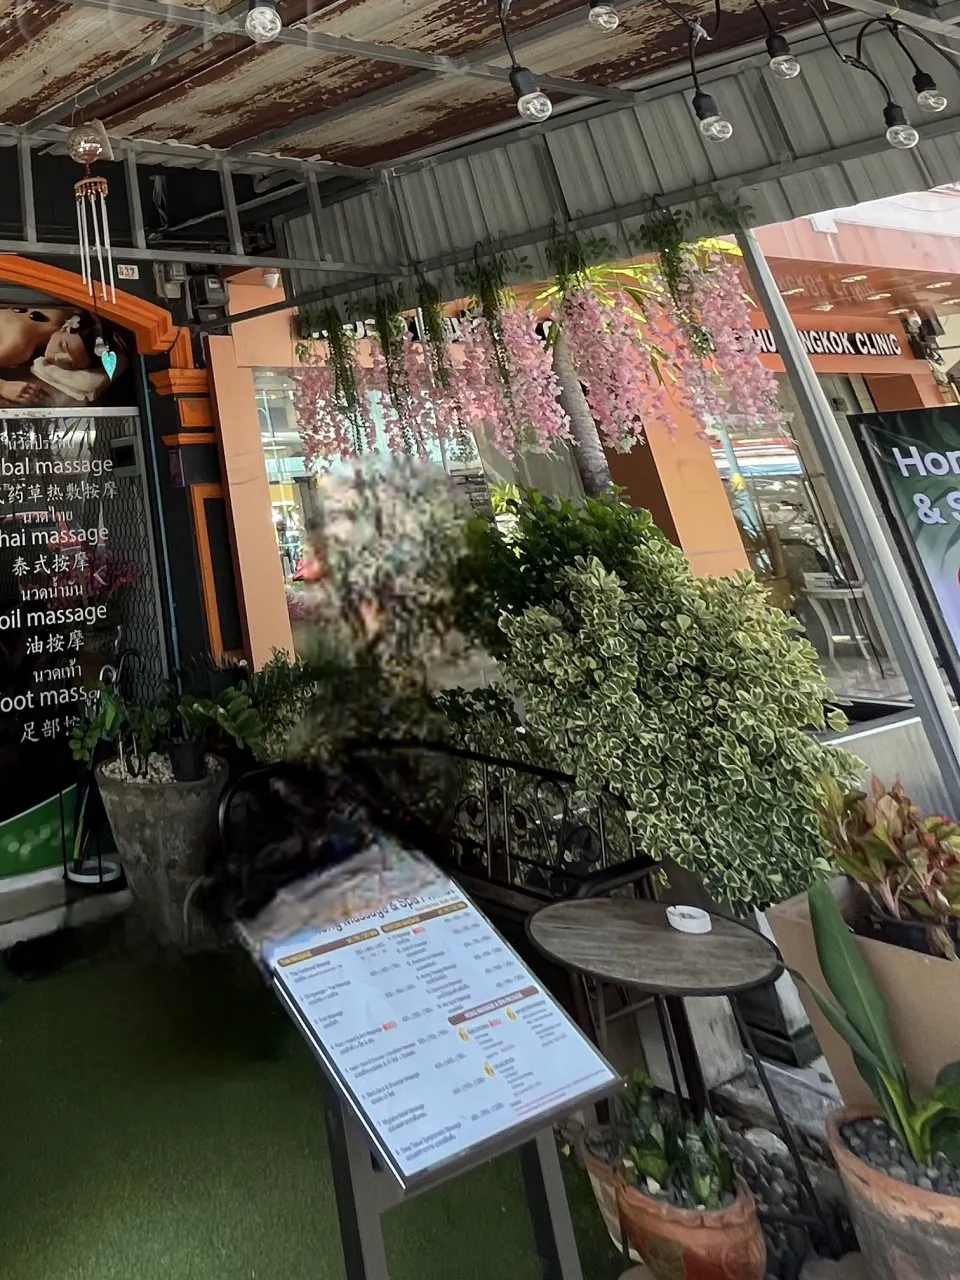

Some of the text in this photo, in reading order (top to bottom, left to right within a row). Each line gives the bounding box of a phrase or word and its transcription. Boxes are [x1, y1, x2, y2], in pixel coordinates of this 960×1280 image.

[855, 332, 902, 357] CLINIC
[35, 458, 113, 476] massage
[913, 493, 948, 524] &
[31, 527, 109, 546] massage
[12, 551, 90, 577] 泰式按摩
[21, 576, 84, 602] นวดน้ำมัน
[27, 604, 107, 627] massage
[25, 629, 85, 655] 油按摩
[33, 658, 82, 683] นวดเท้า
